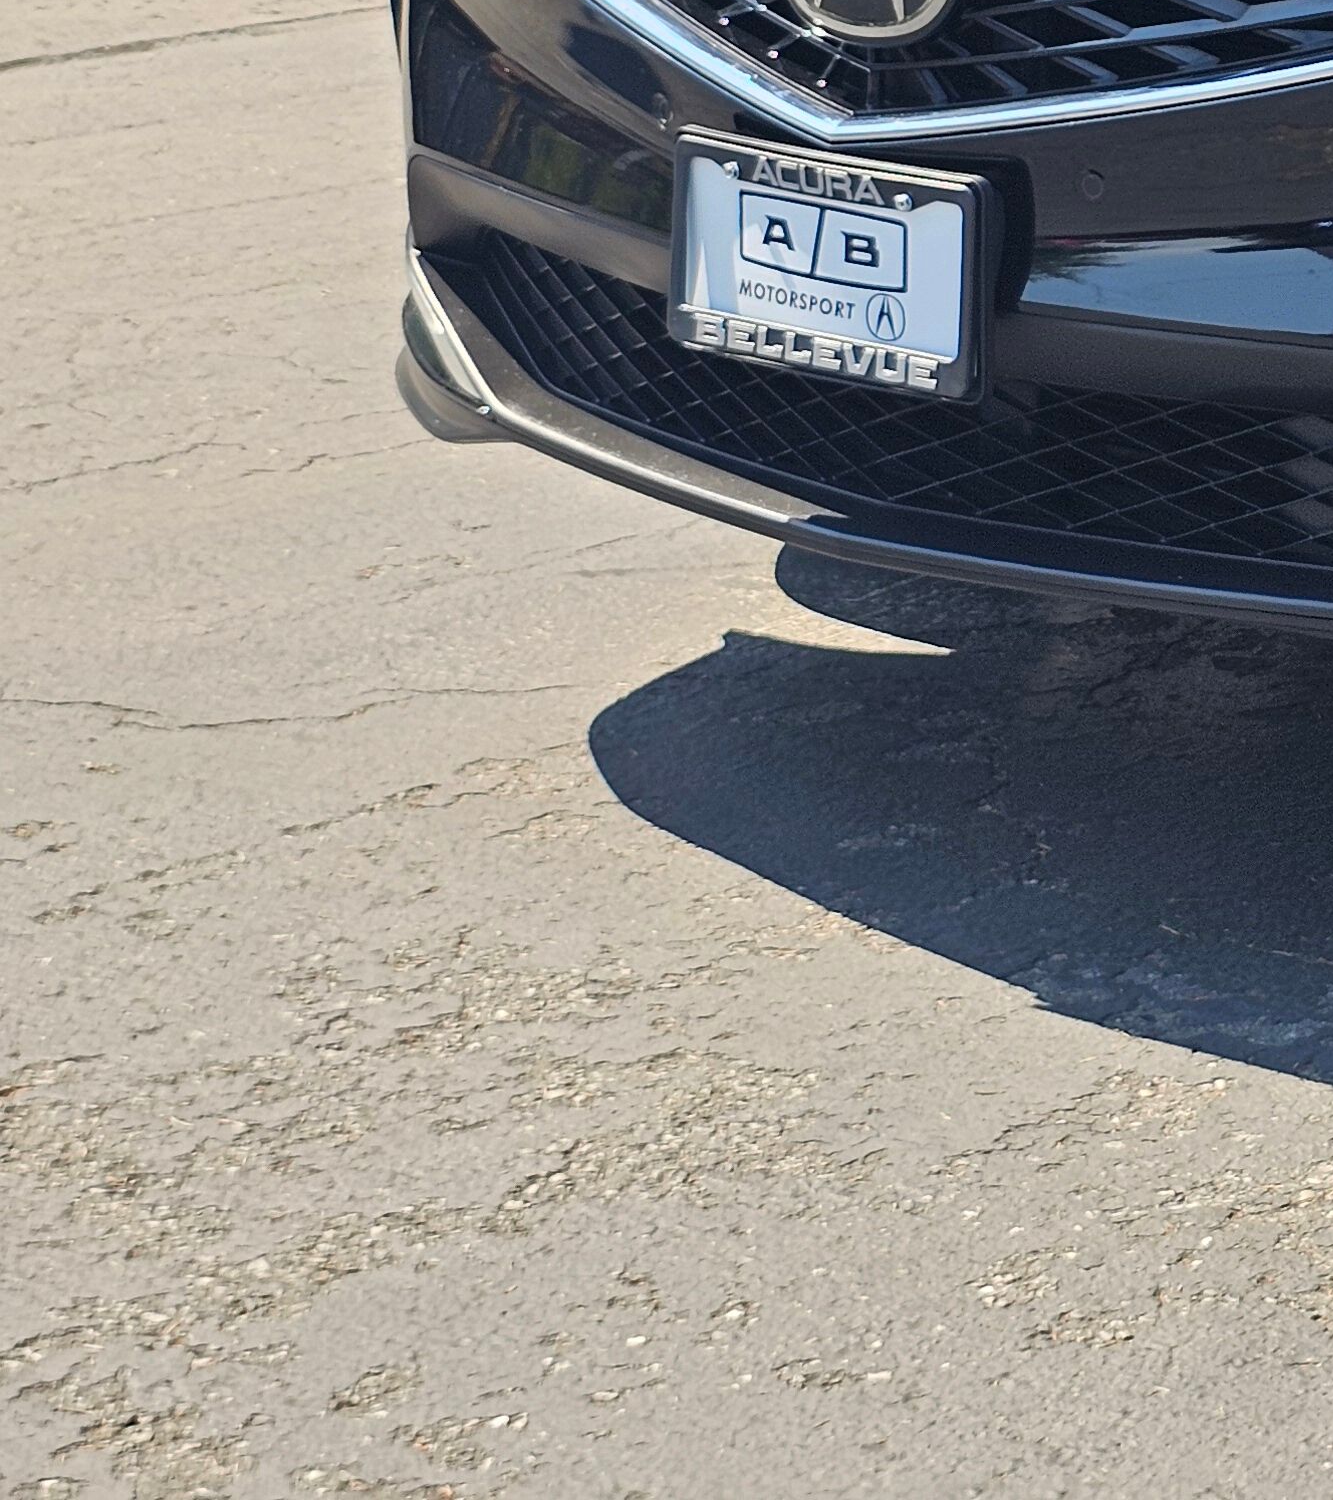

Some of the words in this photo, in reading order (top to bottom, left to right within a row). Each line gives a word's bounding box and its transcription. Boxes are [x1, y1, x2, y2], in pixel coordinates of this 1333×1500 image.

[751, 155, 885, 206] ACURA
[762, 214, 796, 252] A
[840, 230, 881, 269] B
[739, 278, 856, 320] MOTORSPORT
[692, 312, 940, 391] BELLEVUE
